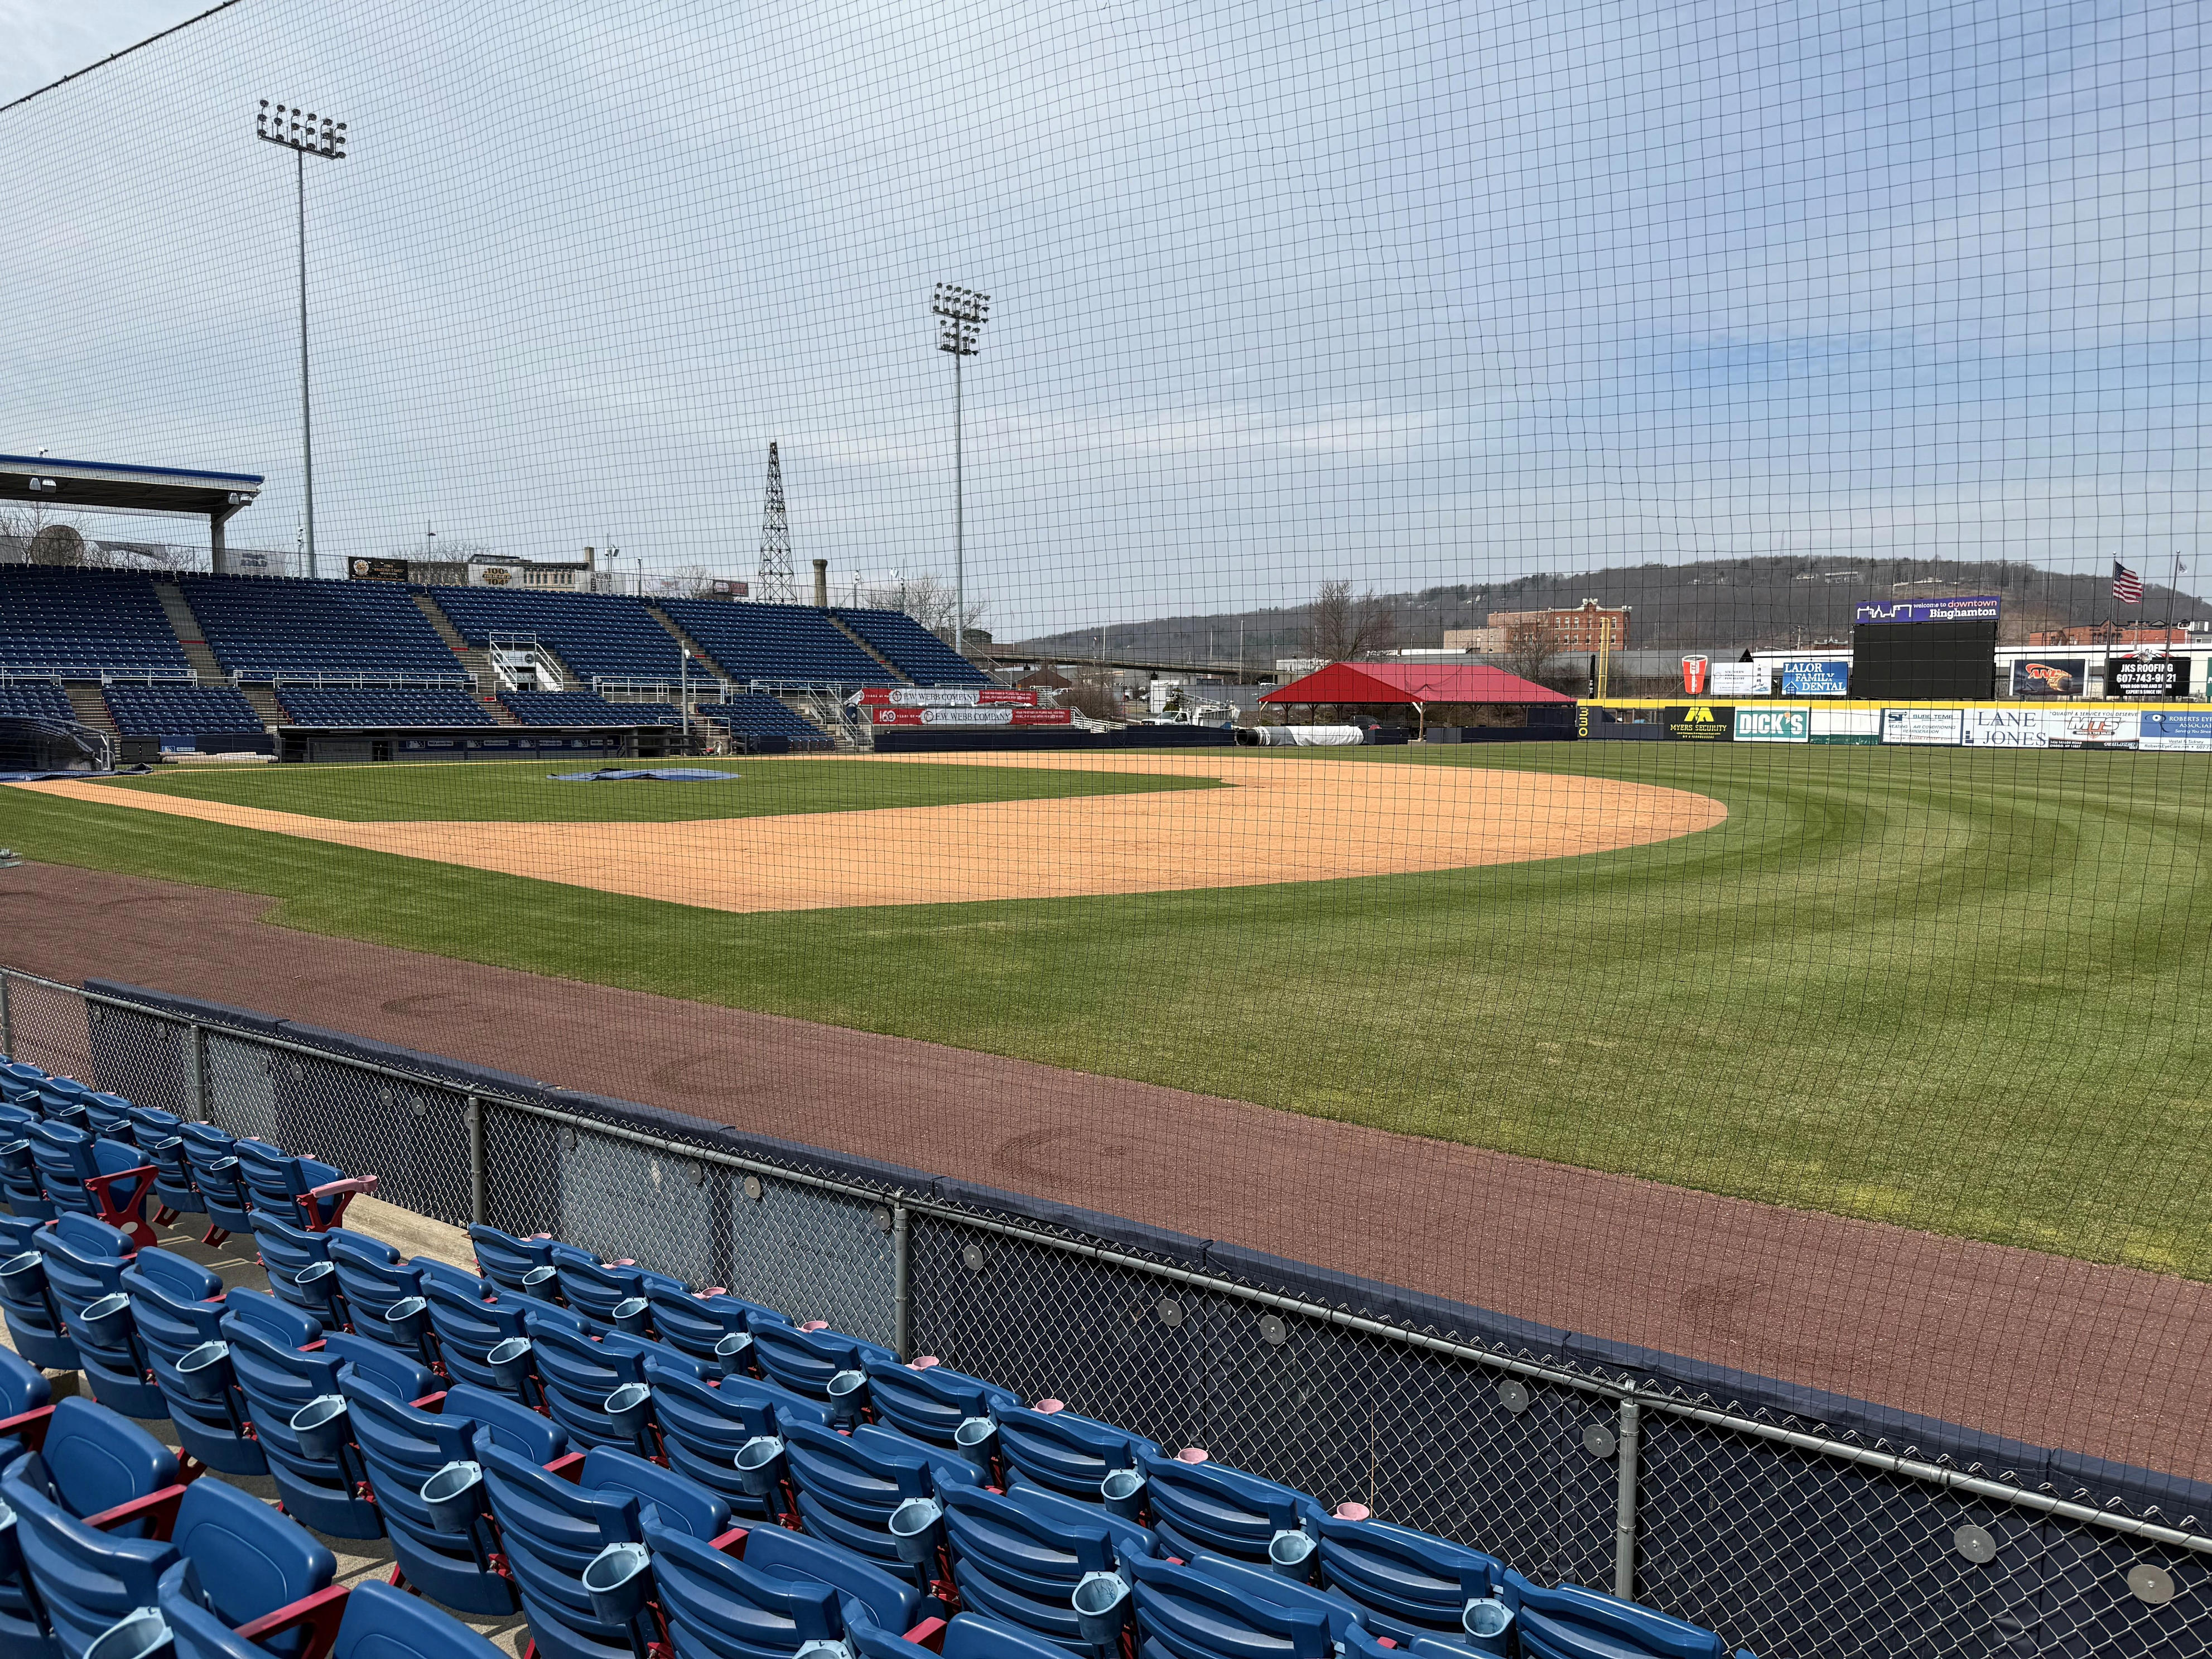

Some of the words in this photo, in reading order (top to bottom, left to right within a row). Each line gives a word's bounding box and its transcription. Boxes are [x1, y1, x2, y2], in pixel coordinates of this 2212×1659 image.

[1929, 607, 1997, 619] Binghamton
[1785, 663, 1822, 673] LALOR
[2121, 664, 2136, 673] JKS
[1795, 673, 1835, 682] FAMILY
[1801, 682, 1847, 691] DENTAL
[879, 710, 896, 722] 160
[1977, 711, 2036, 727] LANE
[1739, 713, 1803, 735] DICK'S
[2067, 717, 2121, 730] MTS
[1983, 731, 2047, 746] JONES
